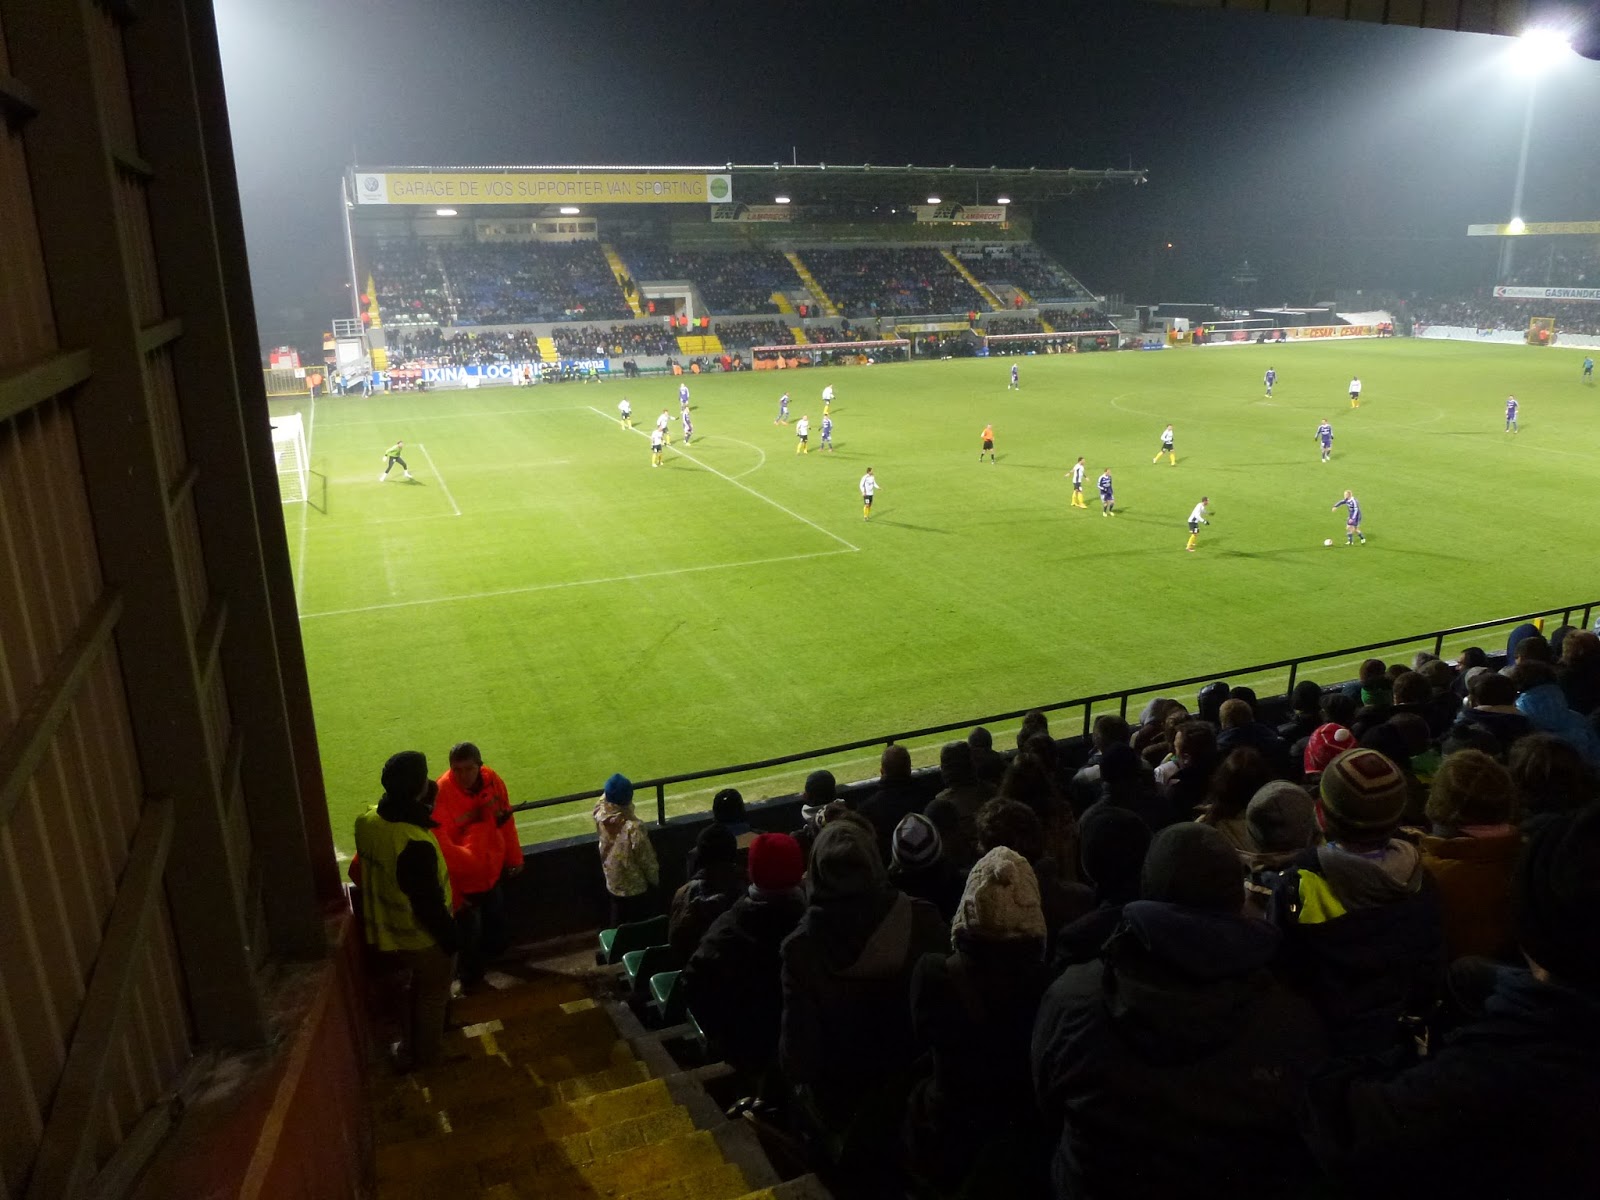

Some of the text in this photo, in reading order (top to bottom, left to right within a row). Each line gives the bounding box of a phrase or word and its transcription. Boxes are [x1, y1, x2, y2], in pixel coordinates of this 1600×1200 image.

[393, 181, 702, 196] GARAGE DE VOS SUPPORTER VAN SPORTING
[424, 366, 468, 382] IXINA
